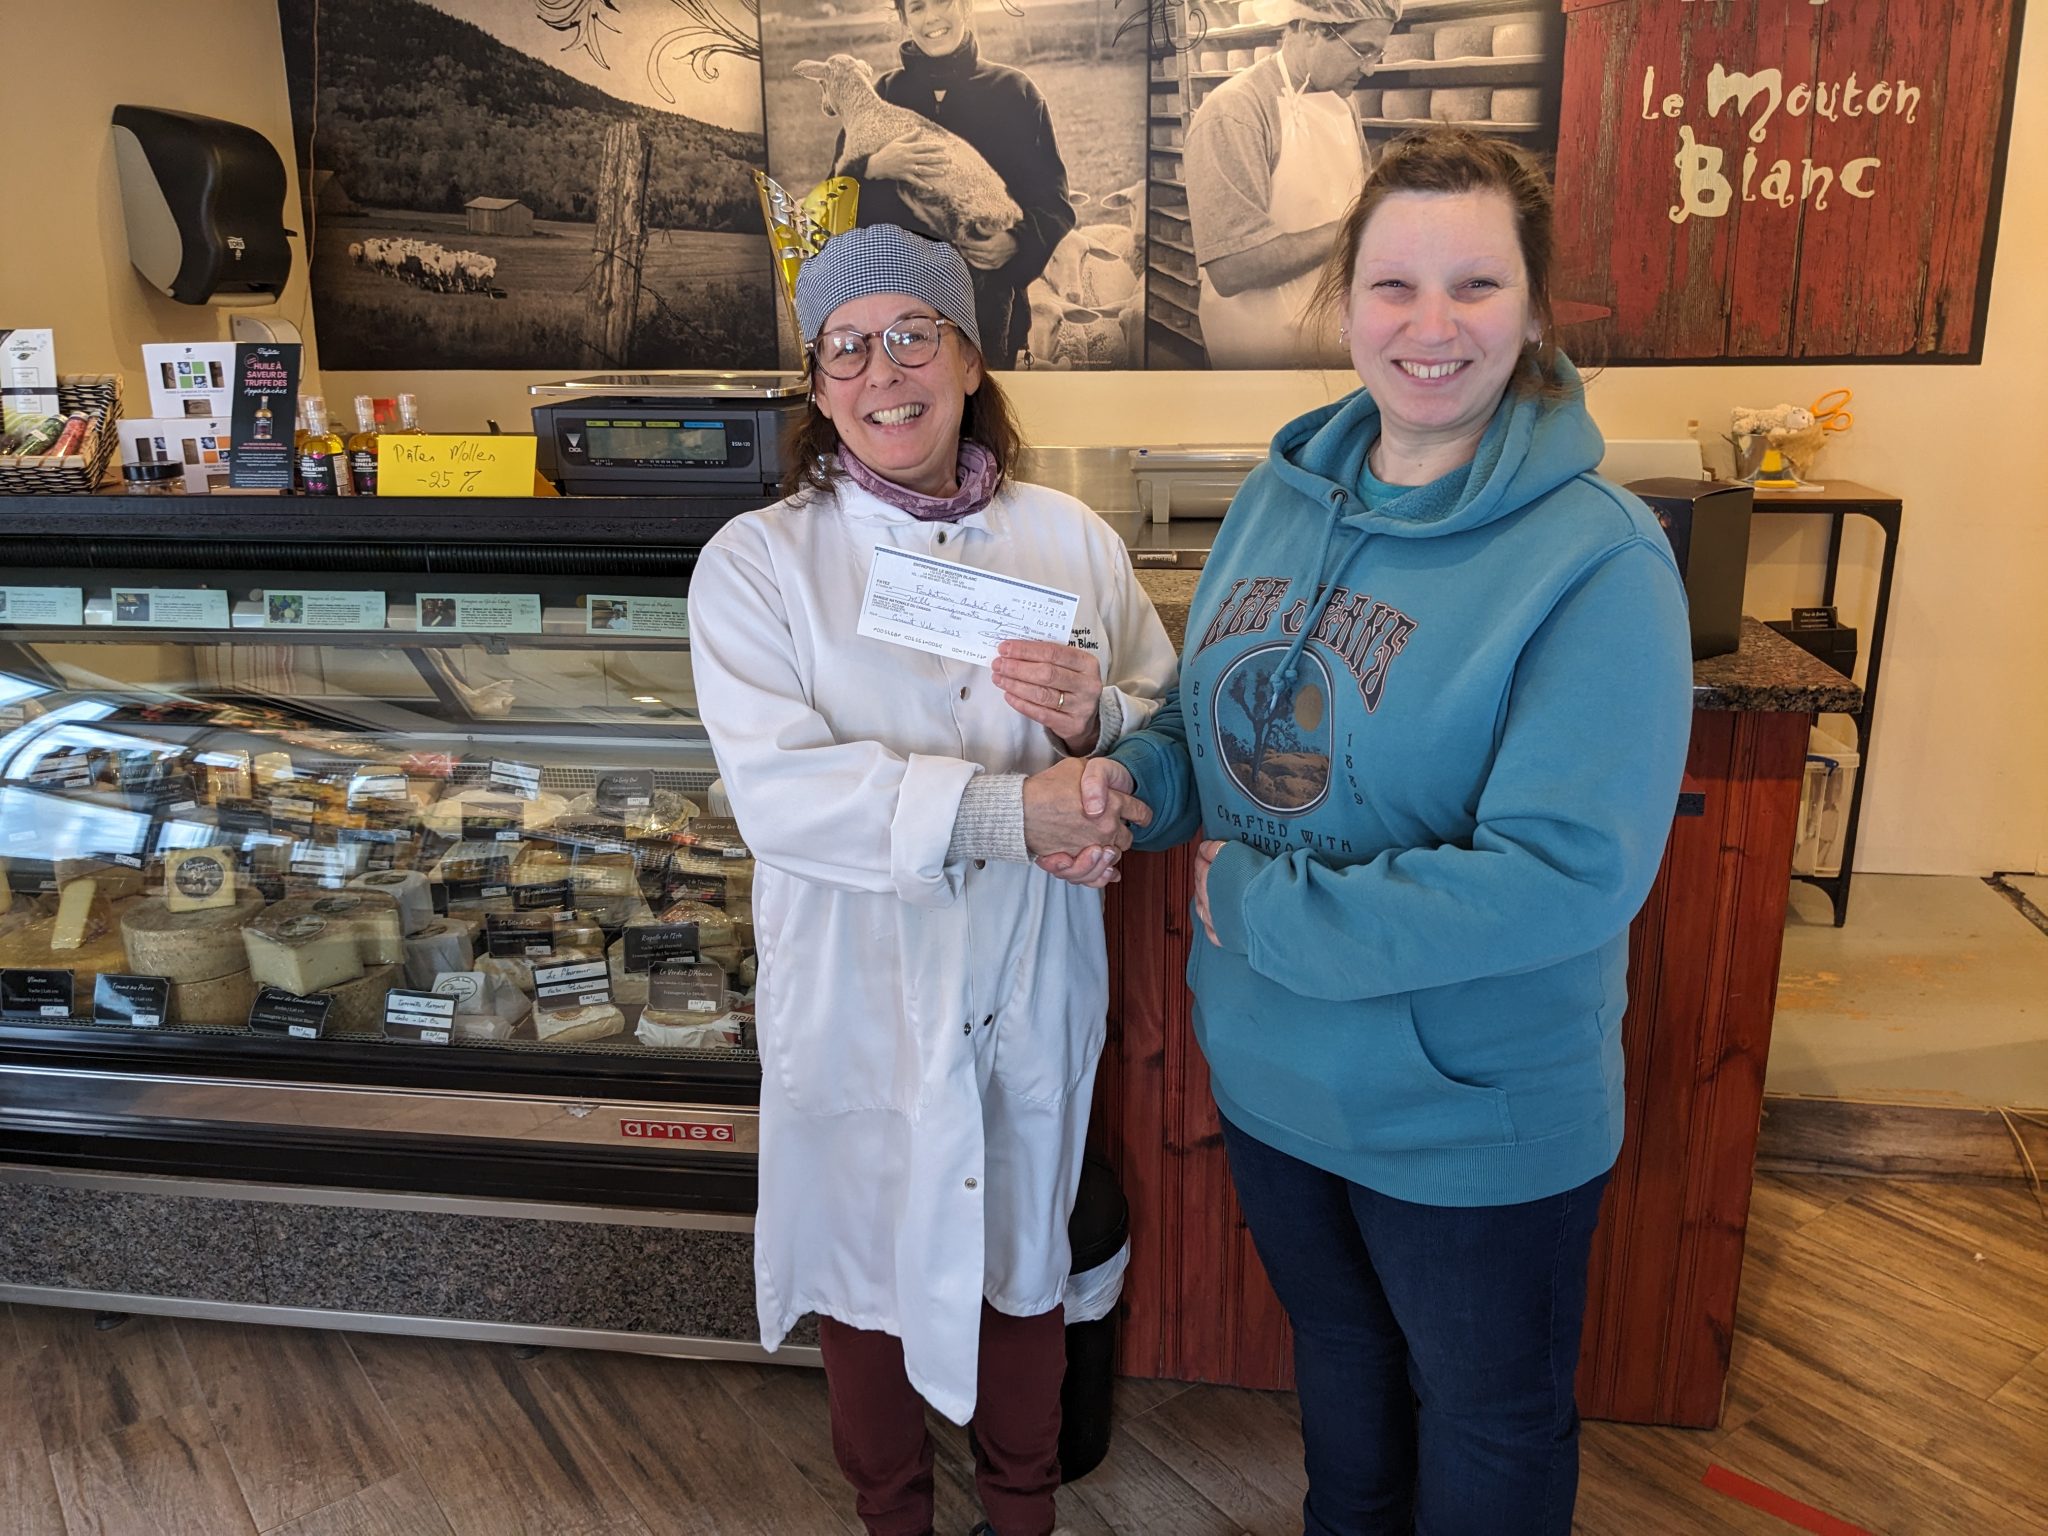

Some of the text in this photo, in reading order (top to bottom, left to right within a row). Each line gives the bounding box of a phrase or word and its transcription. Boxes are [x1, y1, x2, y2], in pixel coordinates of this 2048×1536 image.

[1642, 63, 1921, 143] Le Mouton
[1669, 125, 1881, 225] Blanc
[276, 361, 282, 370] À
[1190, 577, 1293, 666] LEE
[1217, 805, 1353, 853] CRAFTED WITH
